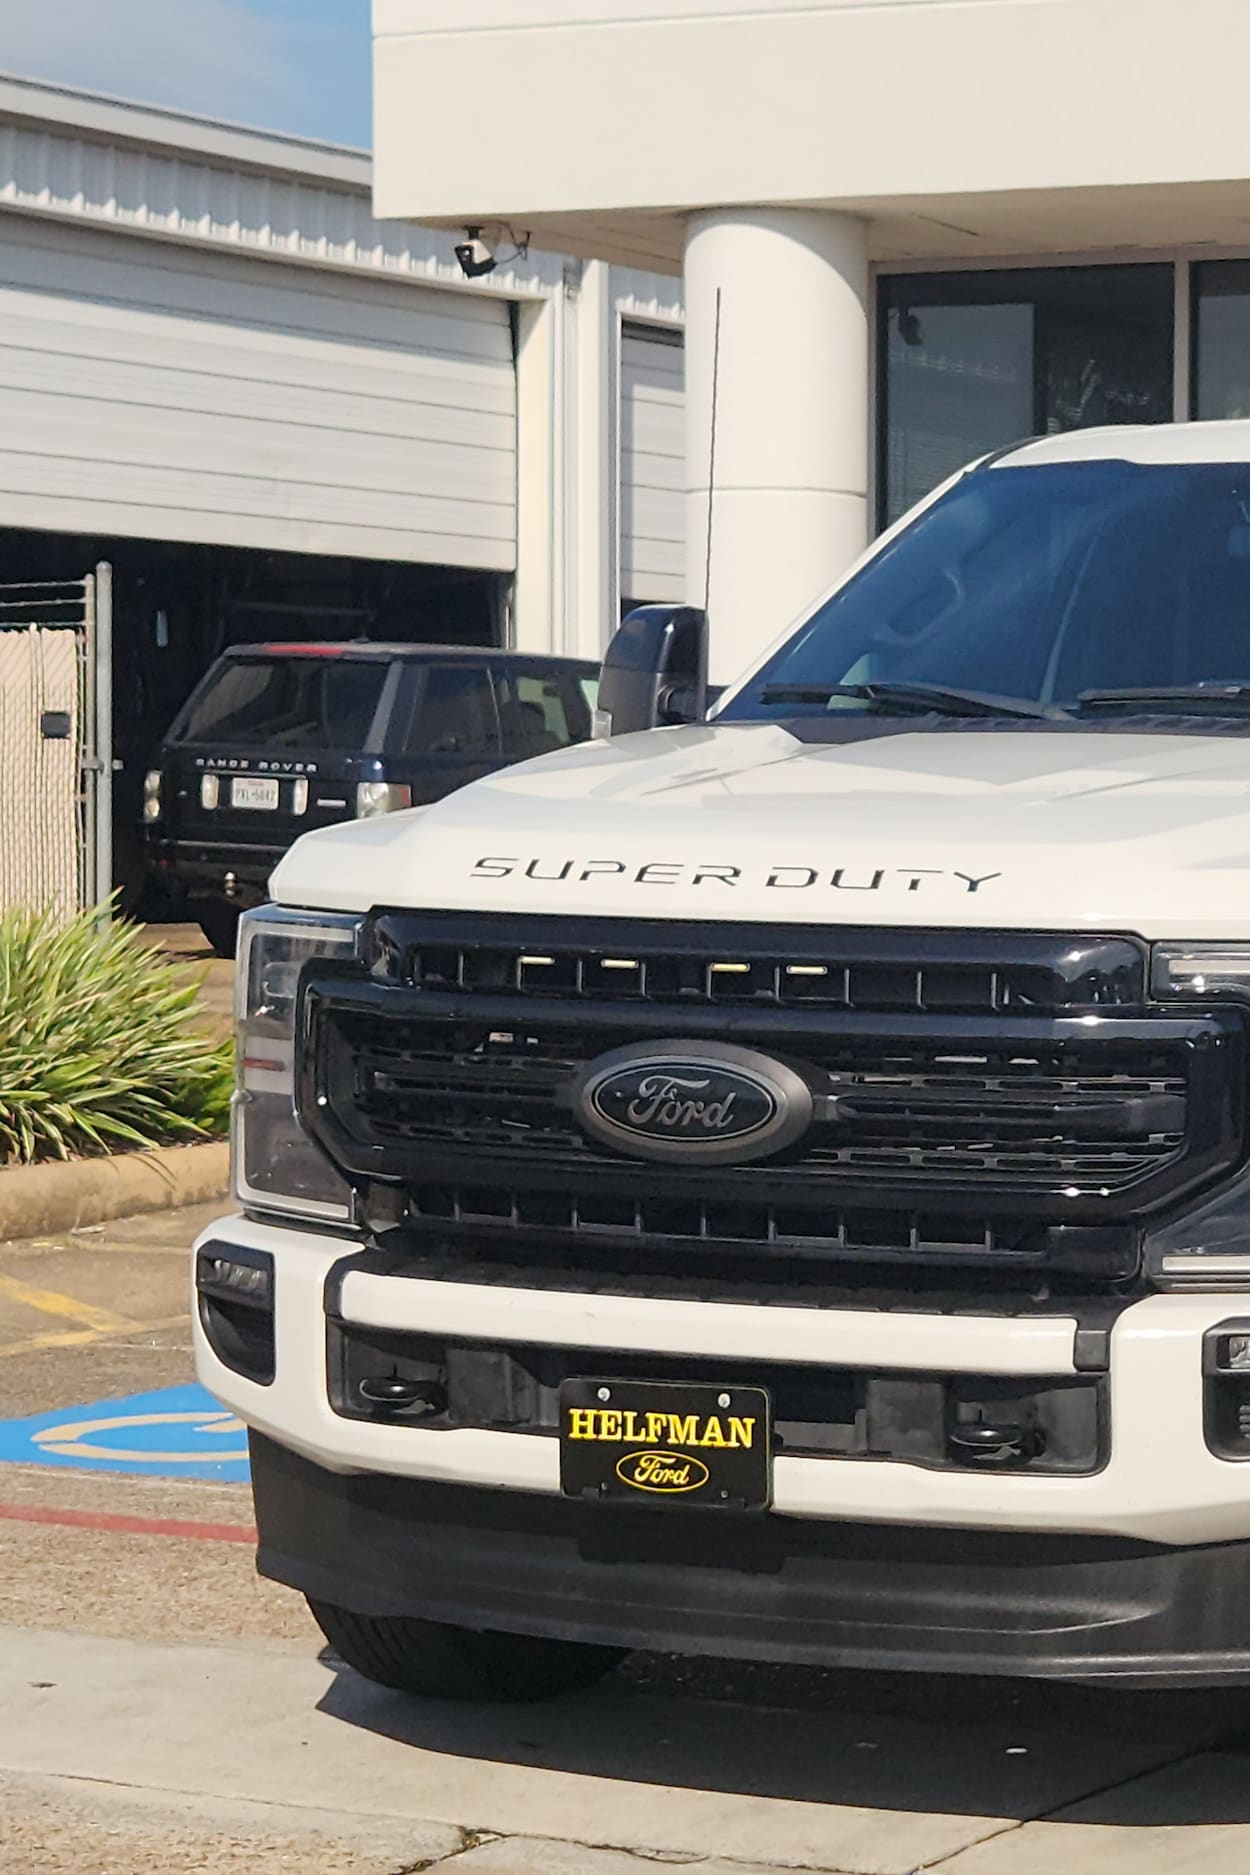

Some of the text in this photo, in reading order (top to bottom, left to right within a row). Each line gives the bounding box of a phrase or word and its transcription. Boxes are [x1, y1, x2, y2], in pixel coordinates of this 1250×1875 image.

[195, 758, 318, 772] RANGE ROVER
[470, 857, 1002, 892] SUPER DUTY
[627, 1075, 736, 1128] Ford
[568, 1408, 756, 1448] HELFMAN
[633, 1454, 690, 1485] Ford
